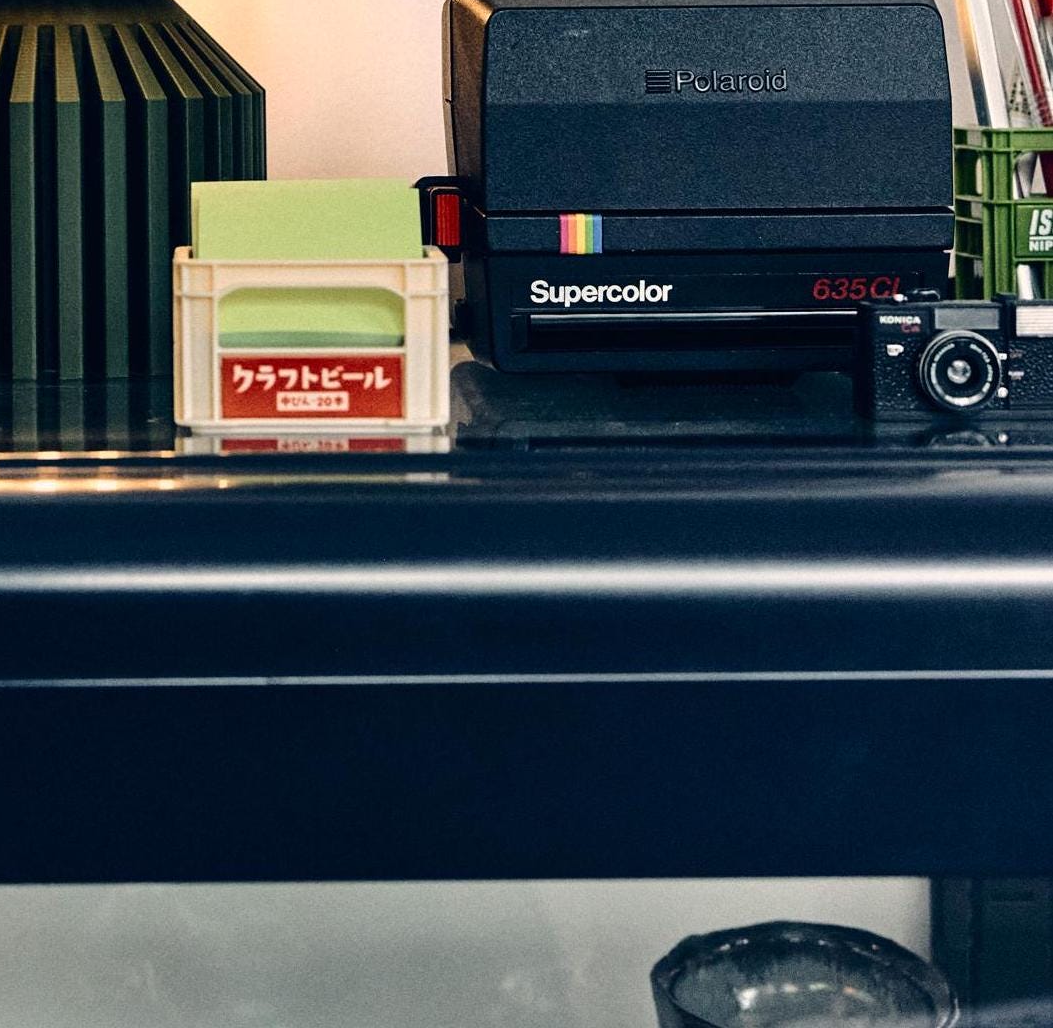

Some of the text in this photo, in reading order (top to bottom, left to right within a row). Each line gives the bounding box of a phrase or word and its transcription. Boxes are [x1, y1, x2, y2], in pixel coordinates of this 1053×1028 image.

[676, 69, 788, 92] Polaroid
[530, 279, 673, 308] Supercolor
[879, 315, 922, 325] KONICA
[233, 364, 392, 393] クラフトビール
